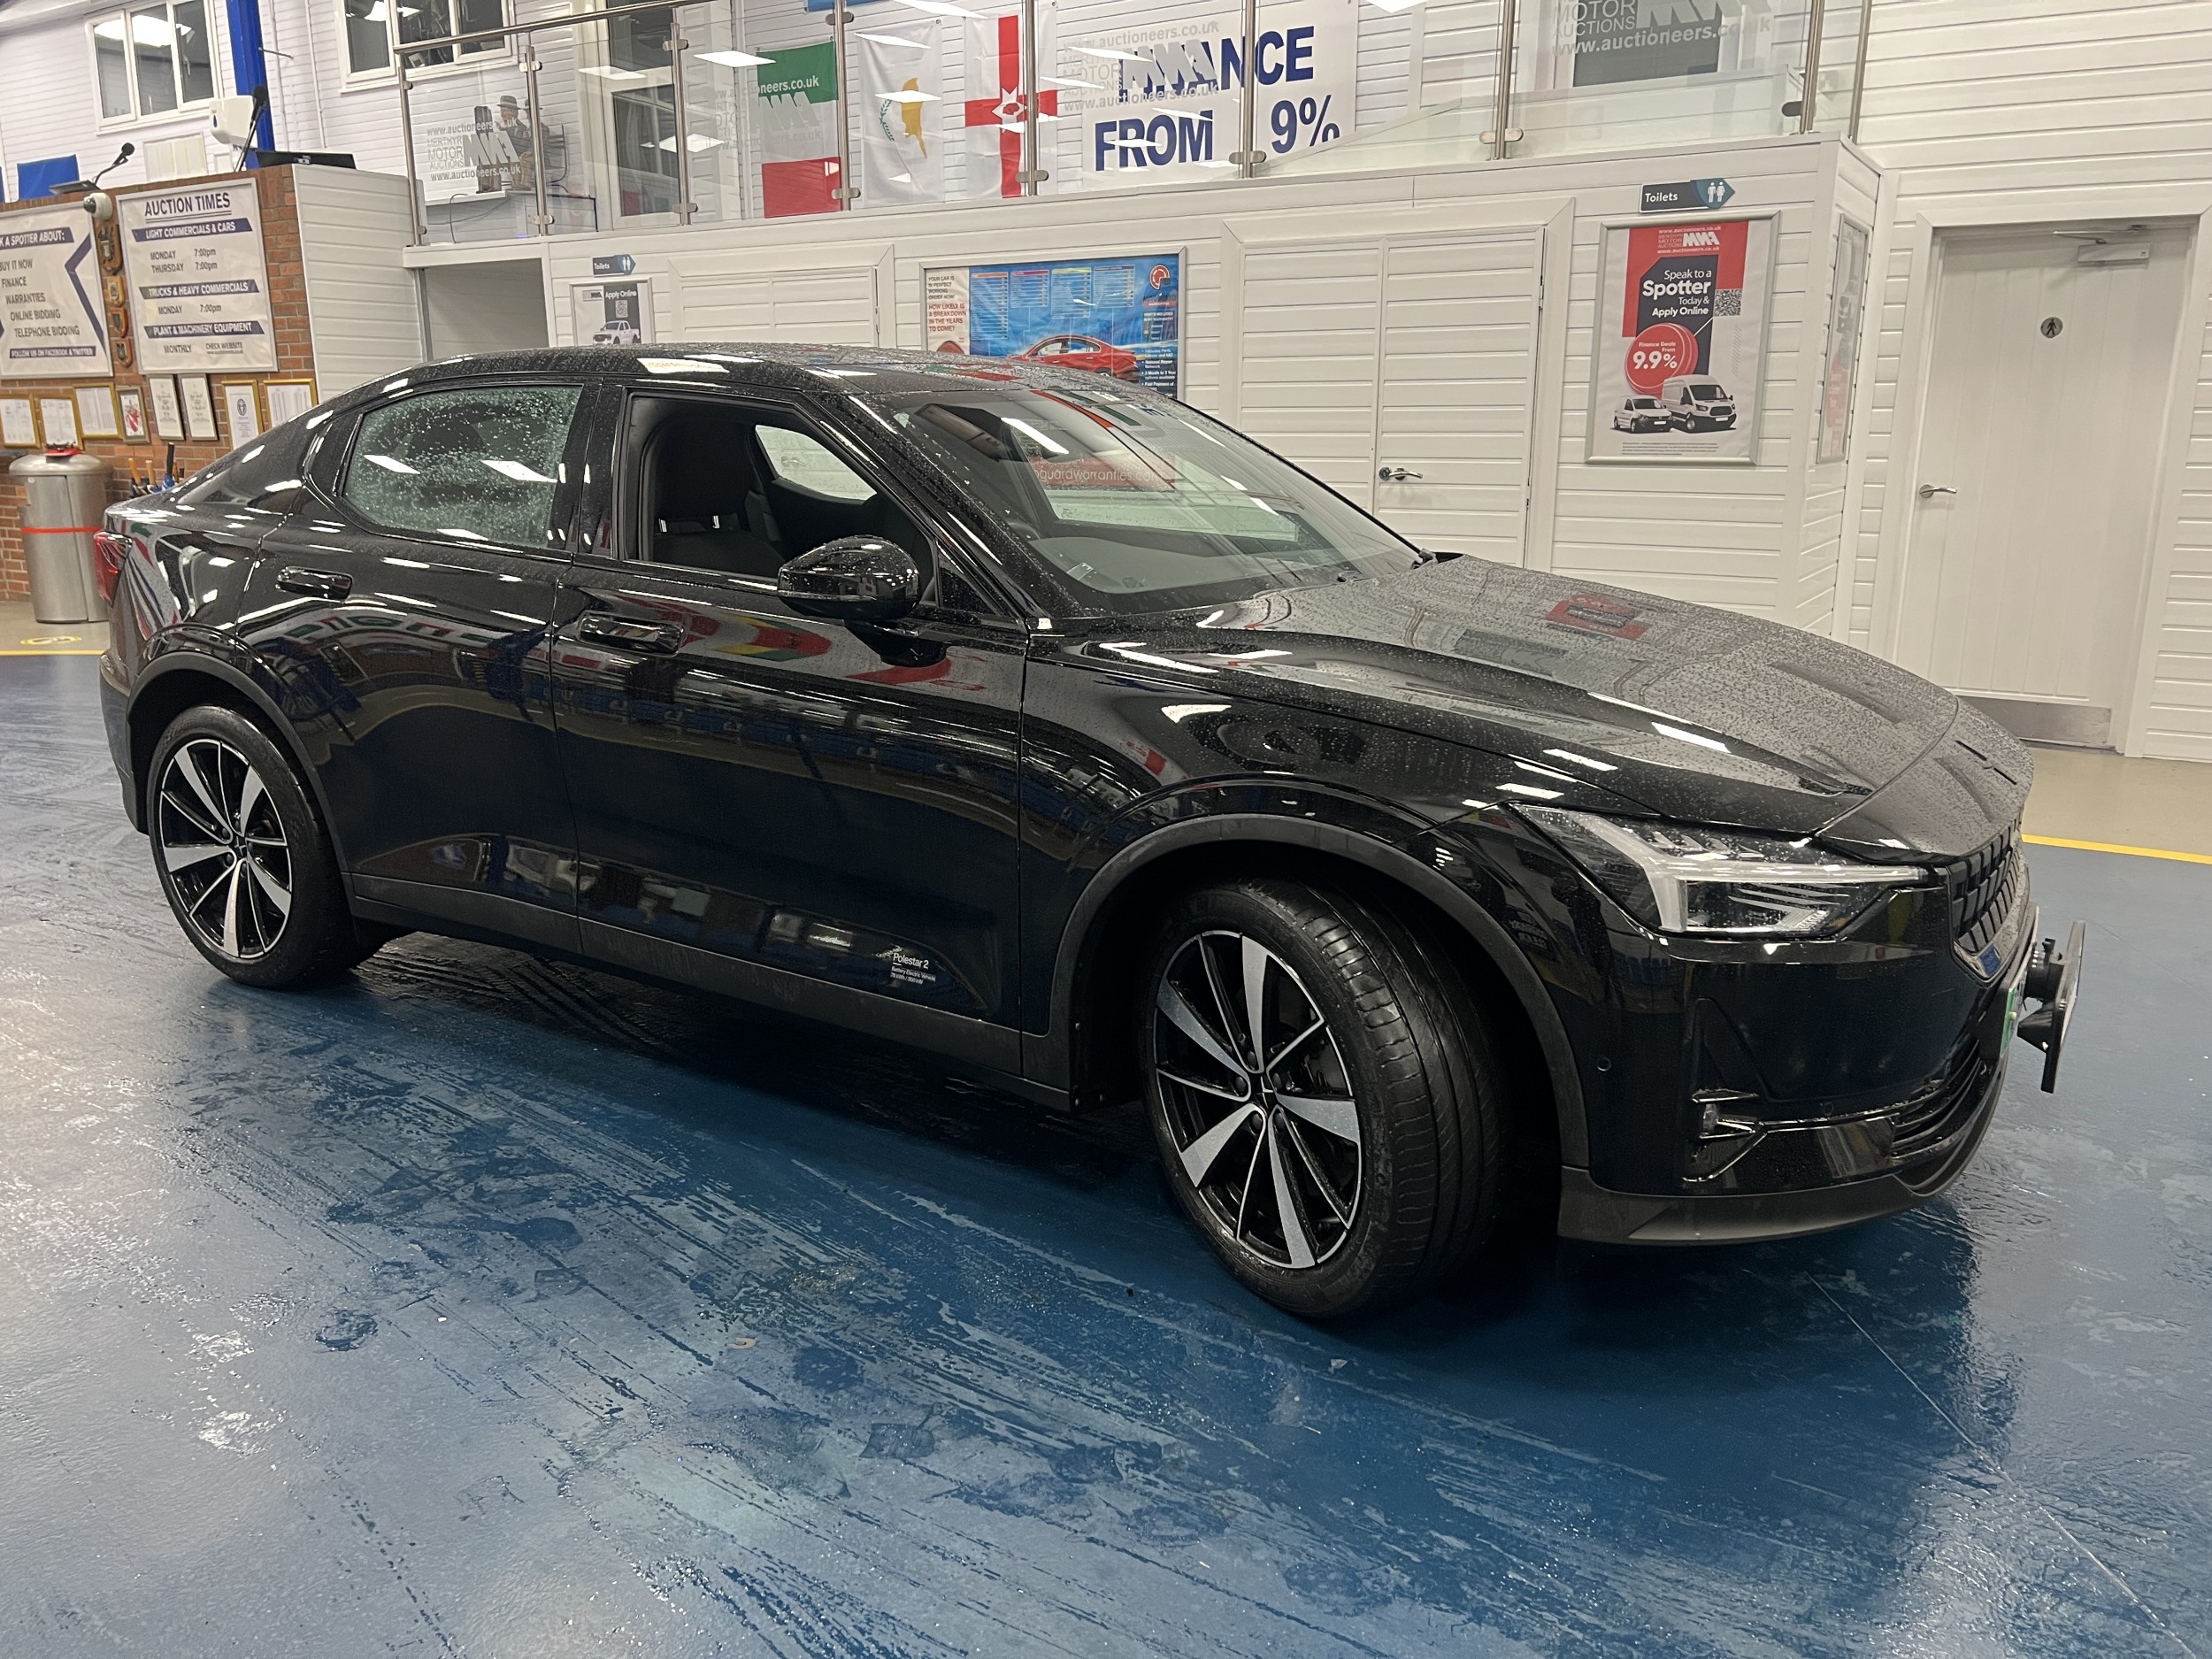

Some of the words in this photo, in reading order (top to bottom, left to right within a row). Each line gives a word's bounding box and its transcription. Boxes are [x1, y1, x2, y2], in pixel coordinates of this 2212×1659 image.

[1552, 16, 1636, 40] AUCTIONS
[426, 118, 518, 136] www.auctioneers.uk
[1094, 109, 1214, 172] FROM
[1271, 94, 1340, 154] 9%
[427, 145, 464, 160] MOTOR
[430, 163, 522, 181] www.auctioneers.co.uk
[144, 196, 193, 217] AUCTION
[195, 192, 231, 211] TIMES
[1645, 192, 1678, 203] Toilets
[146, 228, 164, 240] LIGHT
[164, 225, 211, 238] COMMERCIALS
[211, 224, 217, 233] &
[217, 221, 236, 233] CARS
[5, 236, 10, 247] A
[11, 233, 38, 247] SPOTTER
[39, 230, 65, 242] ABOUT:
[150, 250, 176, 260] MONDAY
[0, 260, 10, 272] BUY
[12, 260, 17, 271] IT
[18, 258, 33, 270] NOW
[151, 263, 184, 273] THURSDAY
[2, 276, 27, 288] FINANCE
[1664, 269, 1693, 281] Speak
[1694, 270, 1704, 279] to
[148, 286, 173, 297] TRUCKS
[179, 284, 199, 296] HEAVY
[201, 281, 249, 294] COMMERCIALS
[1642, 280, 1712, 300] Spotter
[5, 293, 46, 304] WARRANTIES
[1678, 296, 1702, 307] Today
[1703, 296, 1710, 304] &
[11, 311, 34, 321] ONLINE
[35, 309, 61, 320] BIDDING
[158, 305, 182, 315] MONDAY
[1652, 307, 1678, 318] Apply
[1679, 306, 1709, 315] Online
[14, 326, 51, 338] TELEPHONE
[52, 325, 81, 336] BIDDING
[153, 325, 173, 336] PLANT
[178, 324, 212, 335] MACHINERY
[213, 321, 253, 333] EQUIPMENT
[164, 344, 192, 354] MONTHLY
[1632, 350, 1678, 370] 9.9%
[893, 953, 923, 968] Polestar
[923, 960, 929, 970] 2
